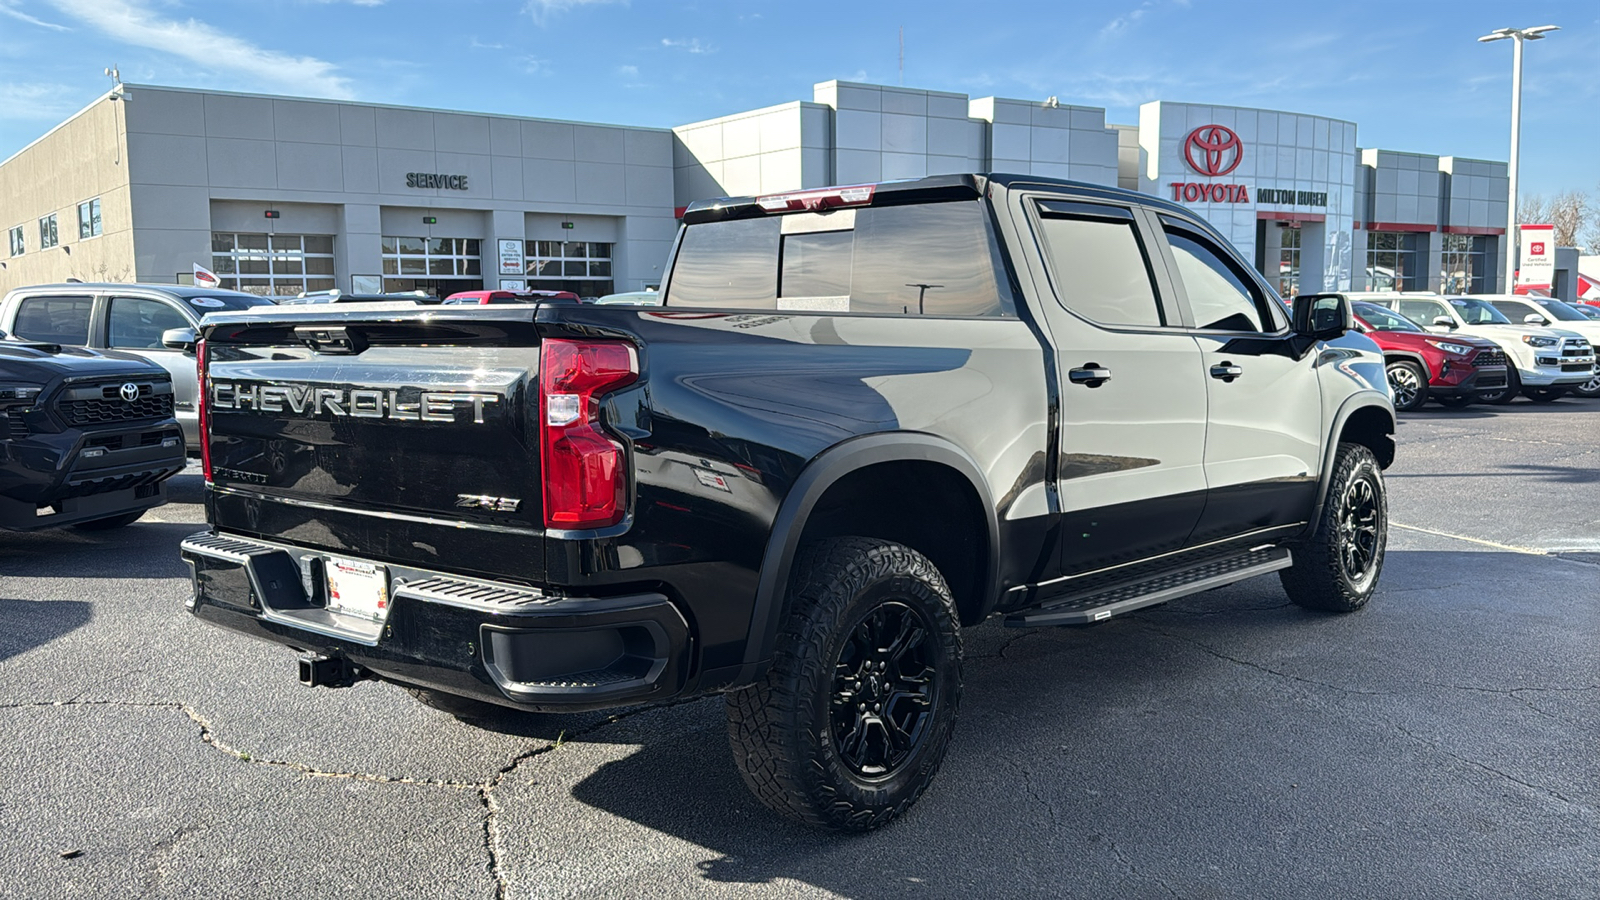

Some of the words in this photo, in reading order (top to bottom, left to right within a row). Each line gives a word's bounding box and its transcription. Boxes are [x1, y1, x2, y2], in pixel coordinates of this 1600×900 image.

[406, 172, 468, 190] SERVICE
[1171, 183, 1249, 203] TOYOTA
[1257, 188, 1296, 205] MILTON
[213, 383, 498, 424] CHEVROLET
